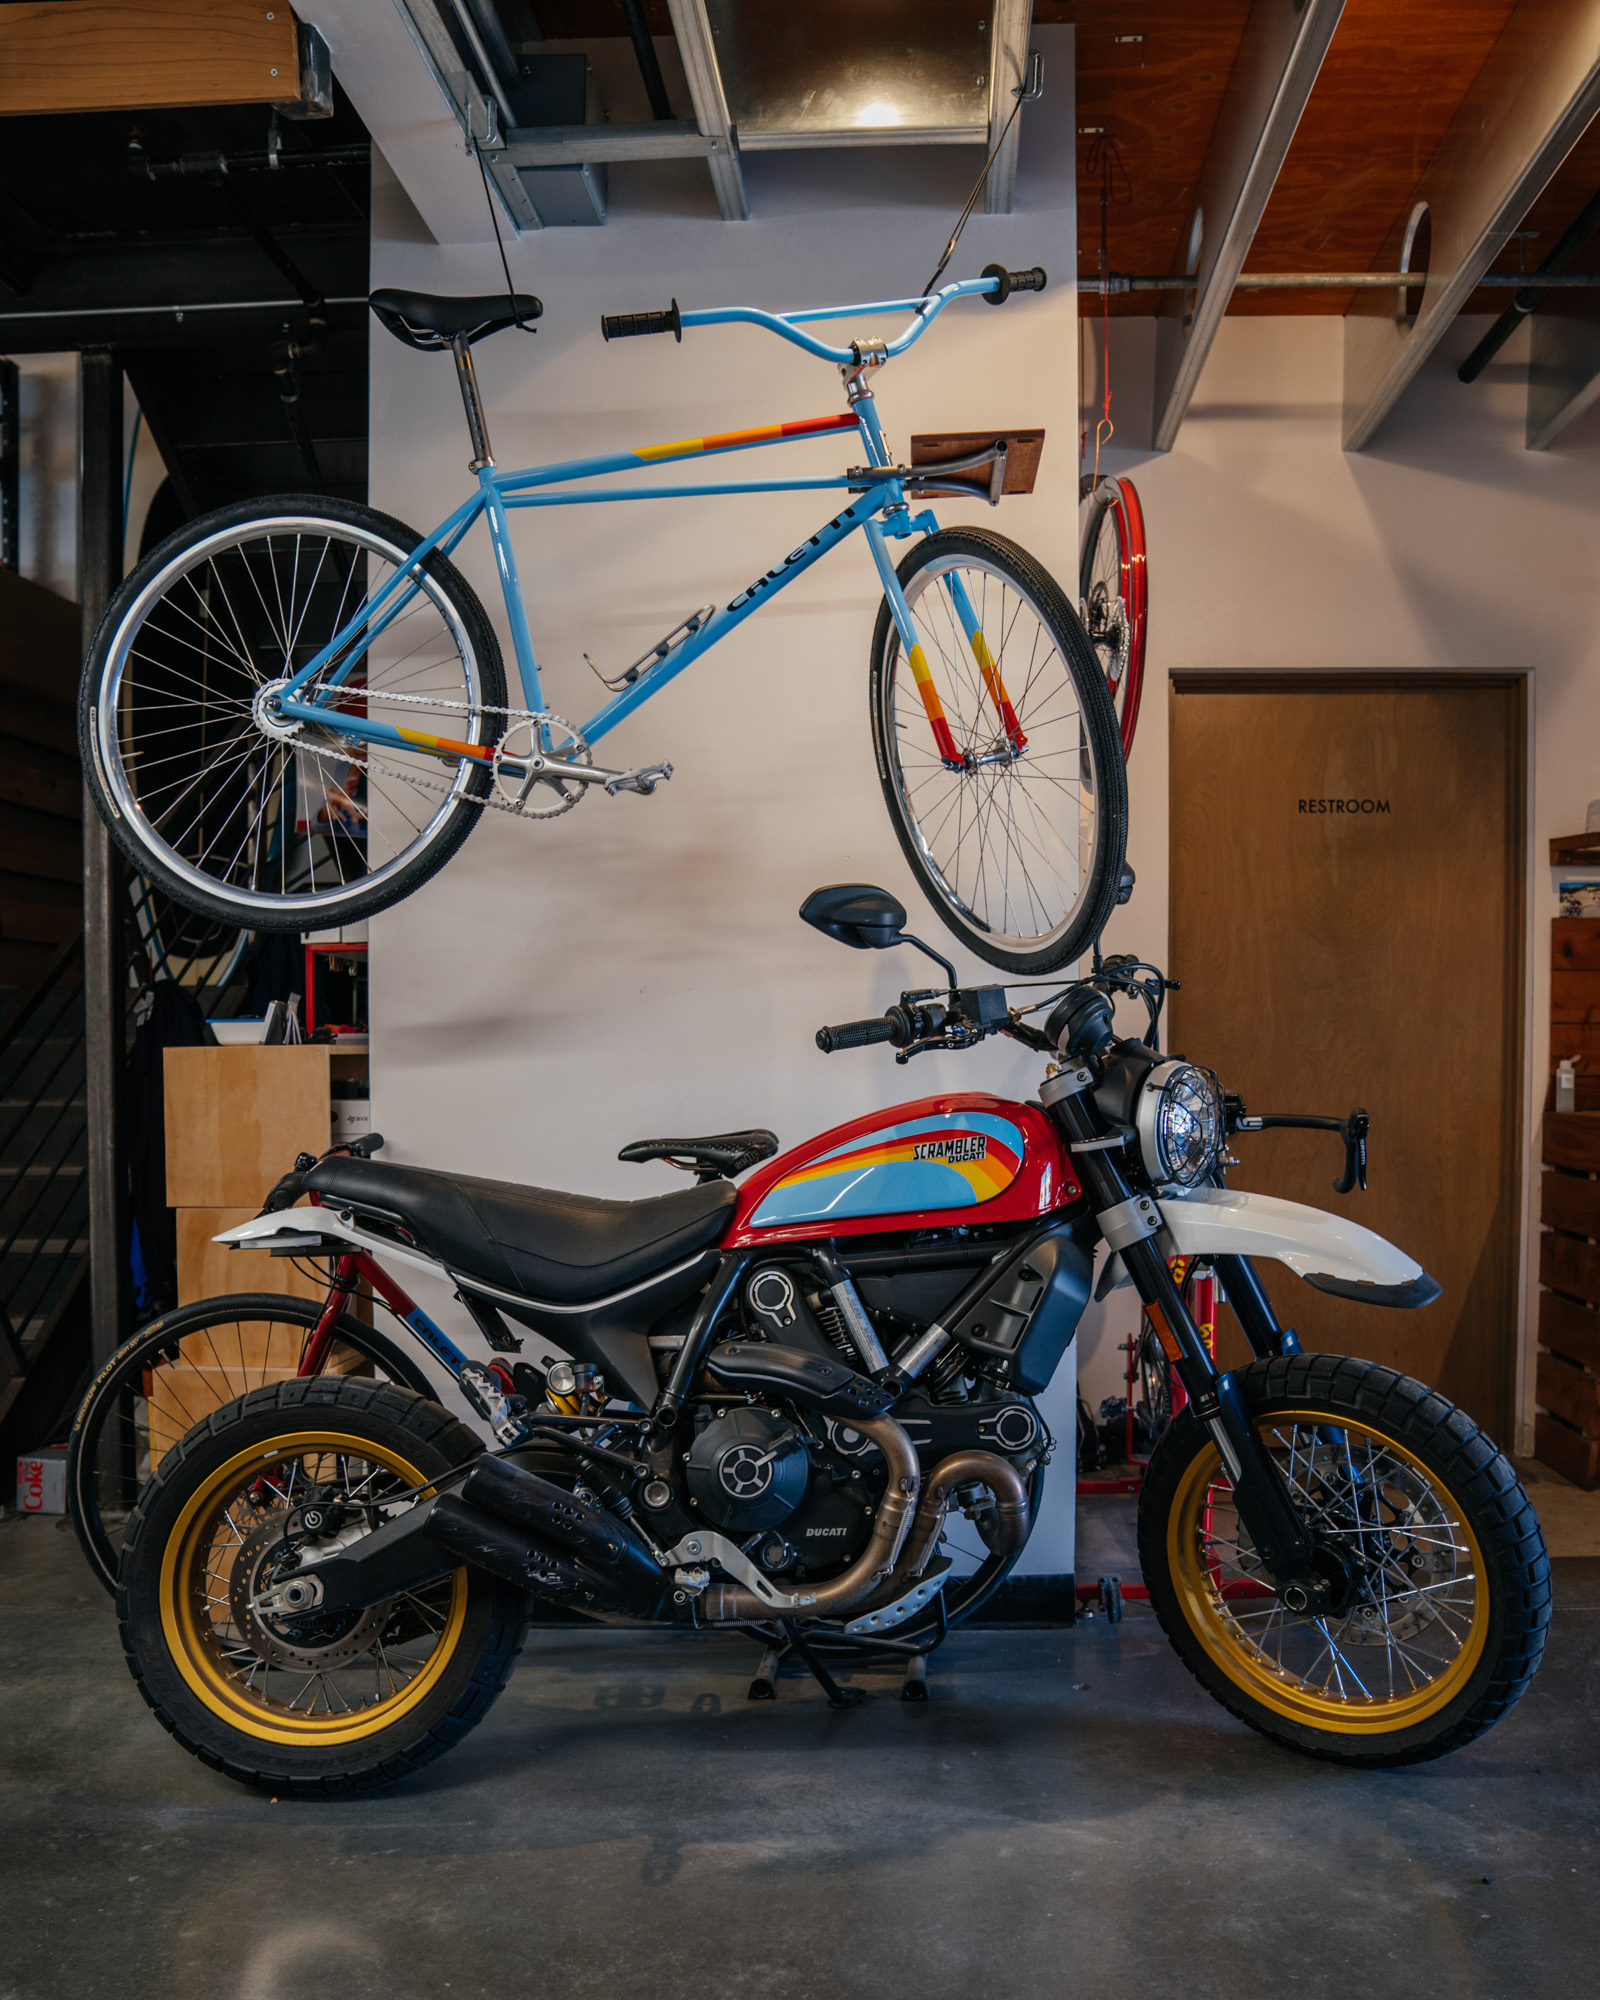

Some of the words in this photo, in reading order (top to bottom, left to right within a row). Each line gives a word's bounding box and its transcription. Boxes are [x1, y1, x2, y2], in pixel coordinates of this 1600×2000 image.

[1298, 799, 1390, 814] RESTROOM
[913, 1136, 986, 1161] SCRAMBLER
[948, 1151, 985, 1164] DUCATI
[414, 1318, 461, 1365] CALET
[97, 1360, 117, 1383] PILOT
[23, 1460, 43, 1510] Coke
[805, 1527, 848, 1537] DUCATI
